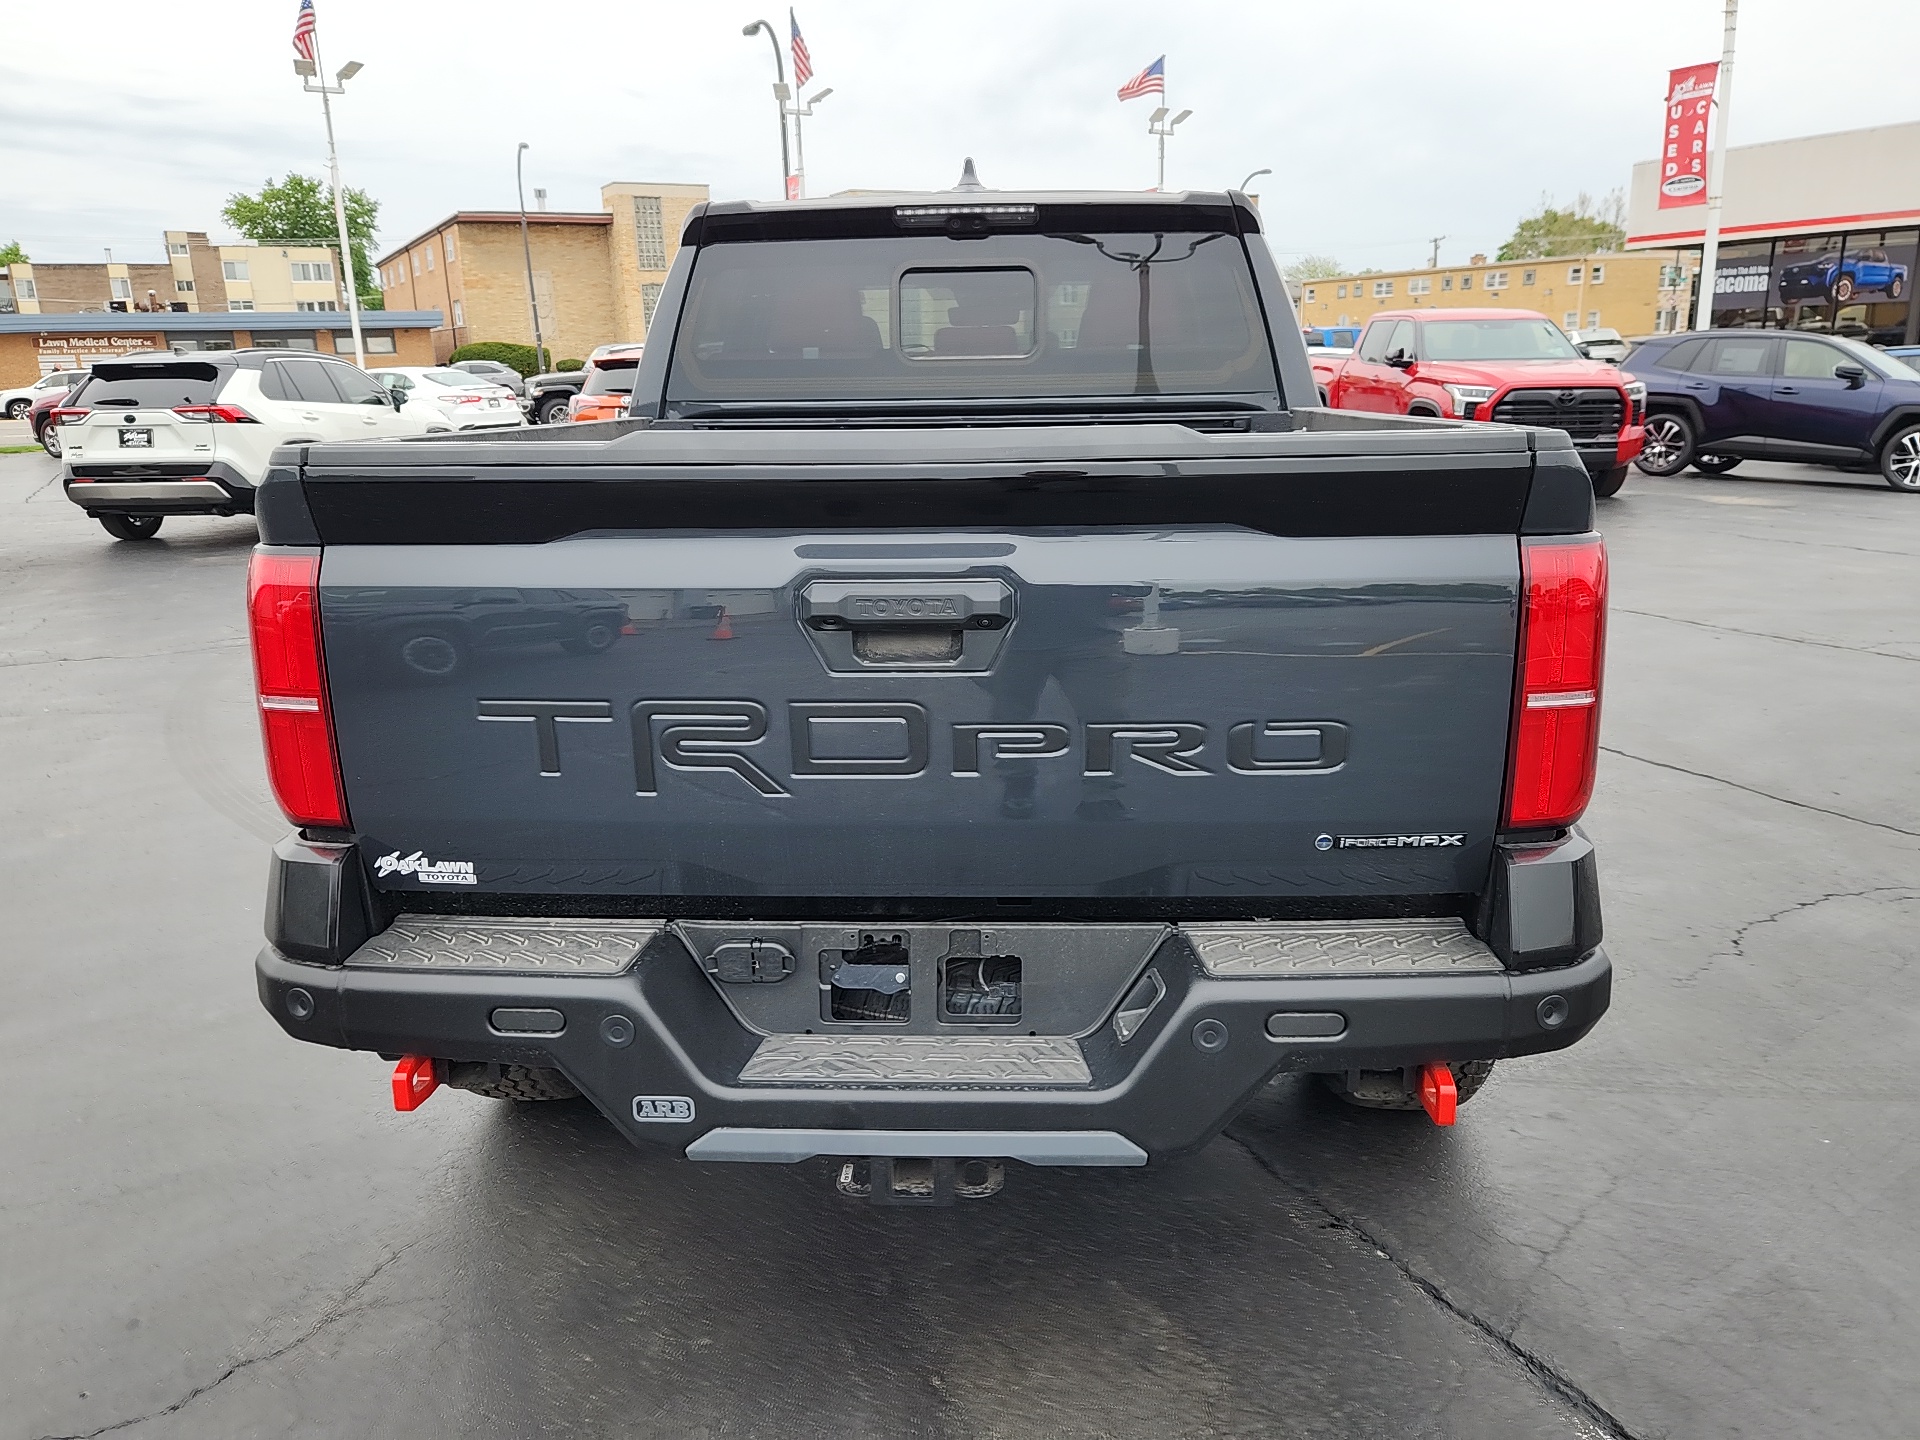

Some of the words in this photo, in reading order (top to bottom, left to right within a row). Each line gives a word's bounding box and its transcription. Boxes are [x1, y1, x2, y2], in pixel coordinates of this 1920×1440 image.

[1665, 104, 1683, 177] USED
[1691, 100, 1708, 173] CARS
[38, 338, 68, 349] Lawn
[69, 337, 109, 348] Medical
[110, 336, 144, 348] Center
[855, 597, 958, 617] TOYOTA
[424, 873, 469, 882] TOYOTA
[639, 1100, 691, 1118] ARB
